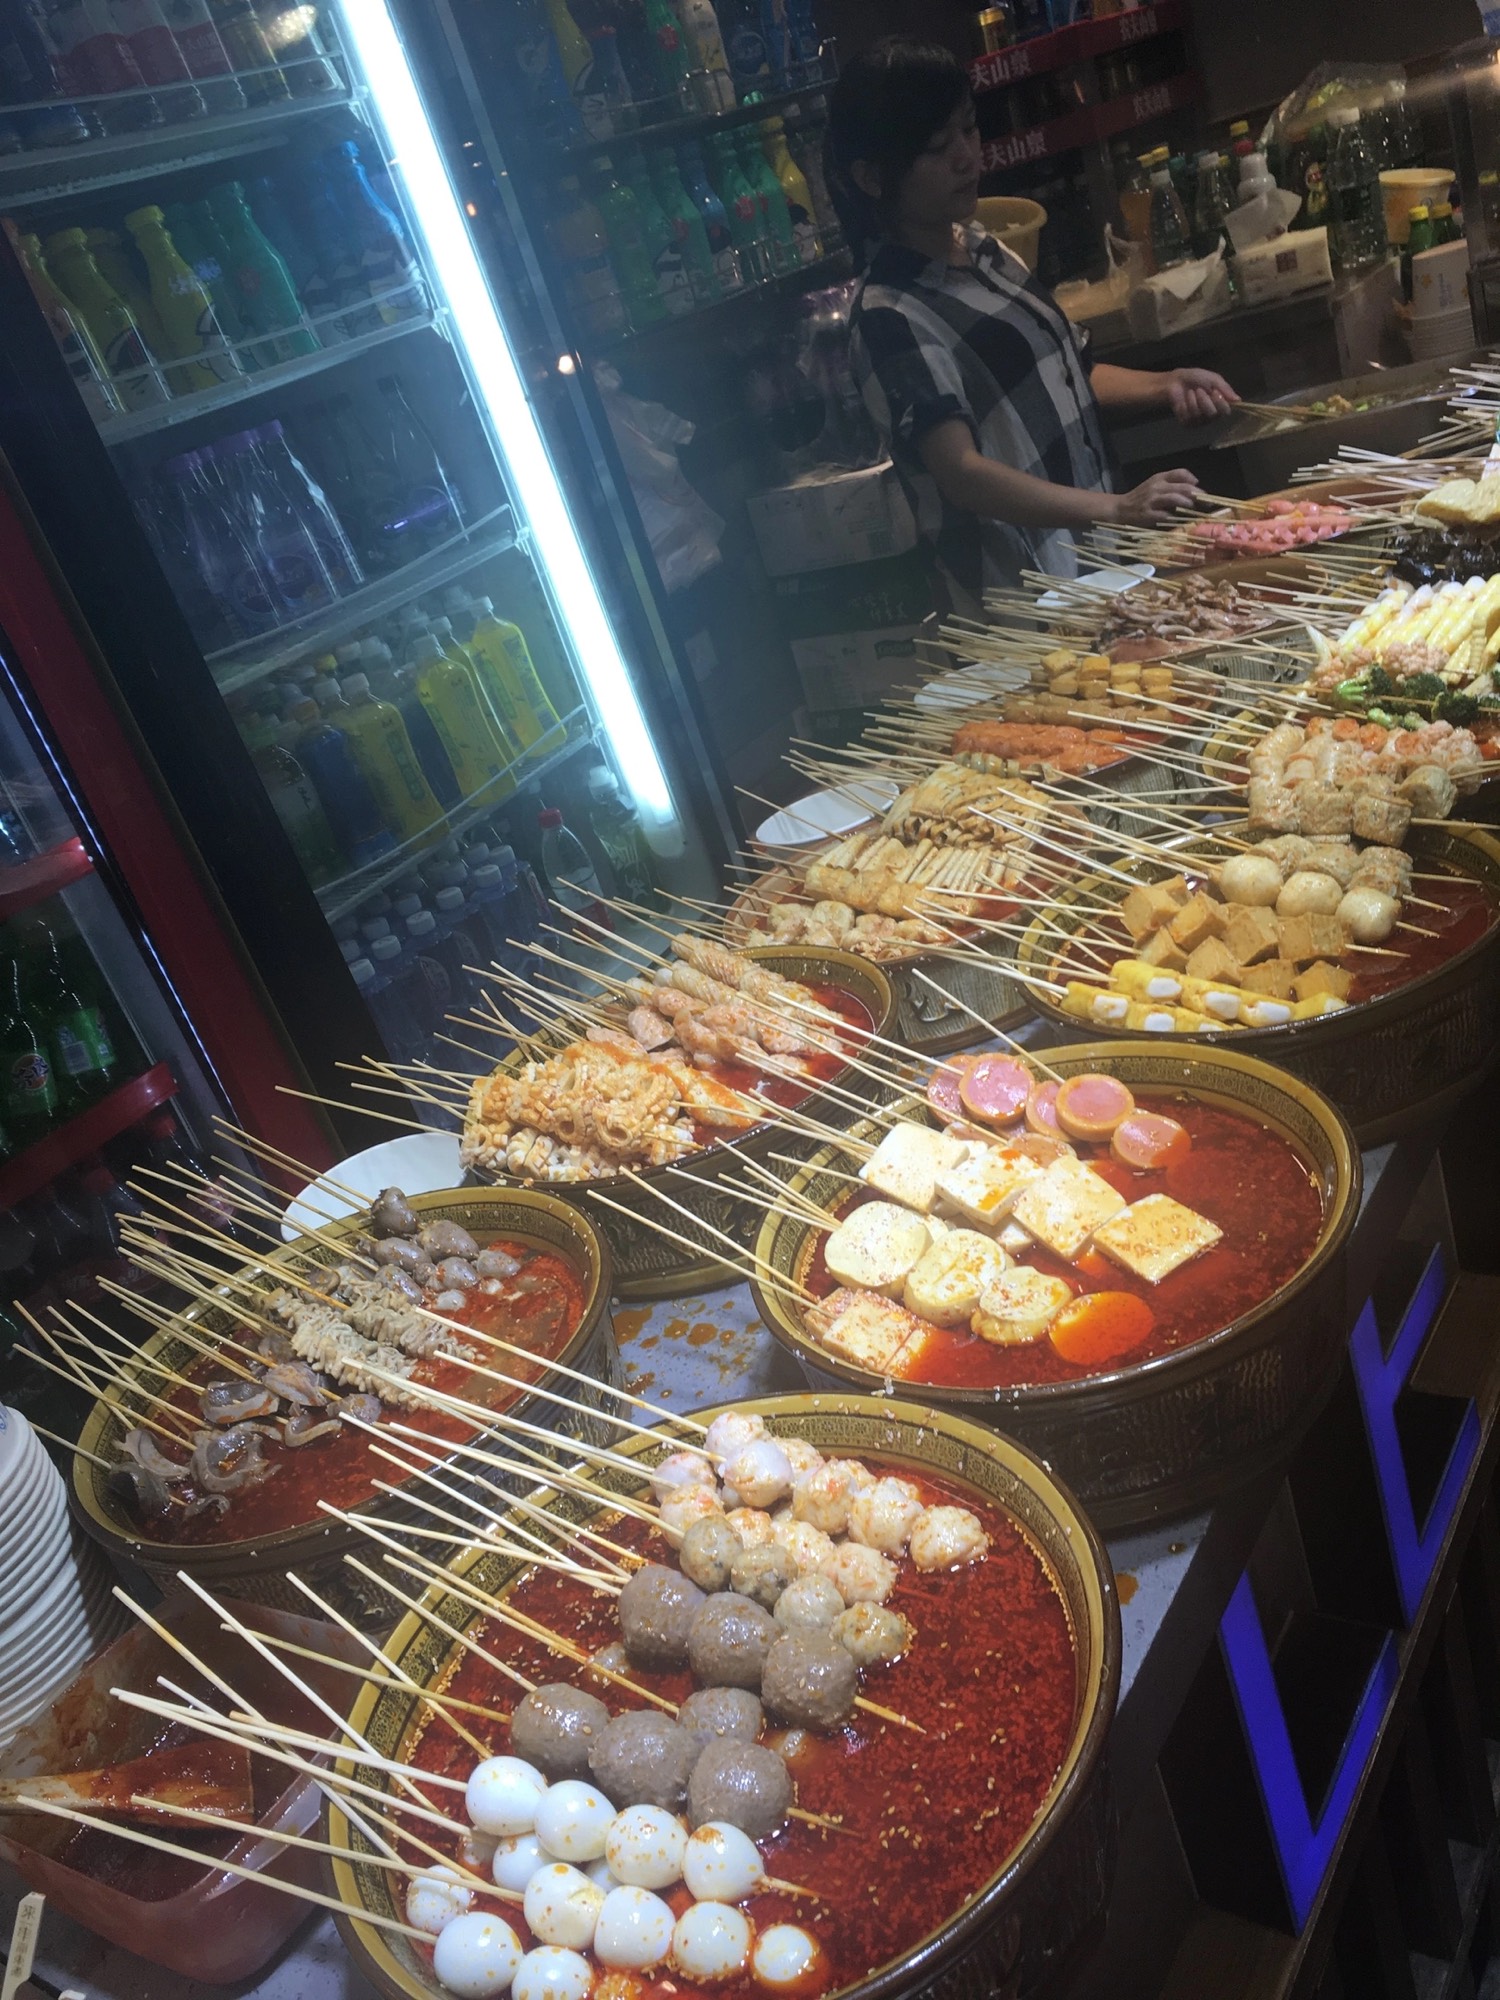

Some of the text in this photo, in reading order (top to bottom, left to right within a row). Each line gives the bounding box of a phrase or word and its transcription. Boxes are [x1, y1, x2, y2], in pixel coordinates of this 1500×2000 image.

[970, 48, 1033, 93] 夫山泉
[979, 129, 1047, 173] 夫山泉
